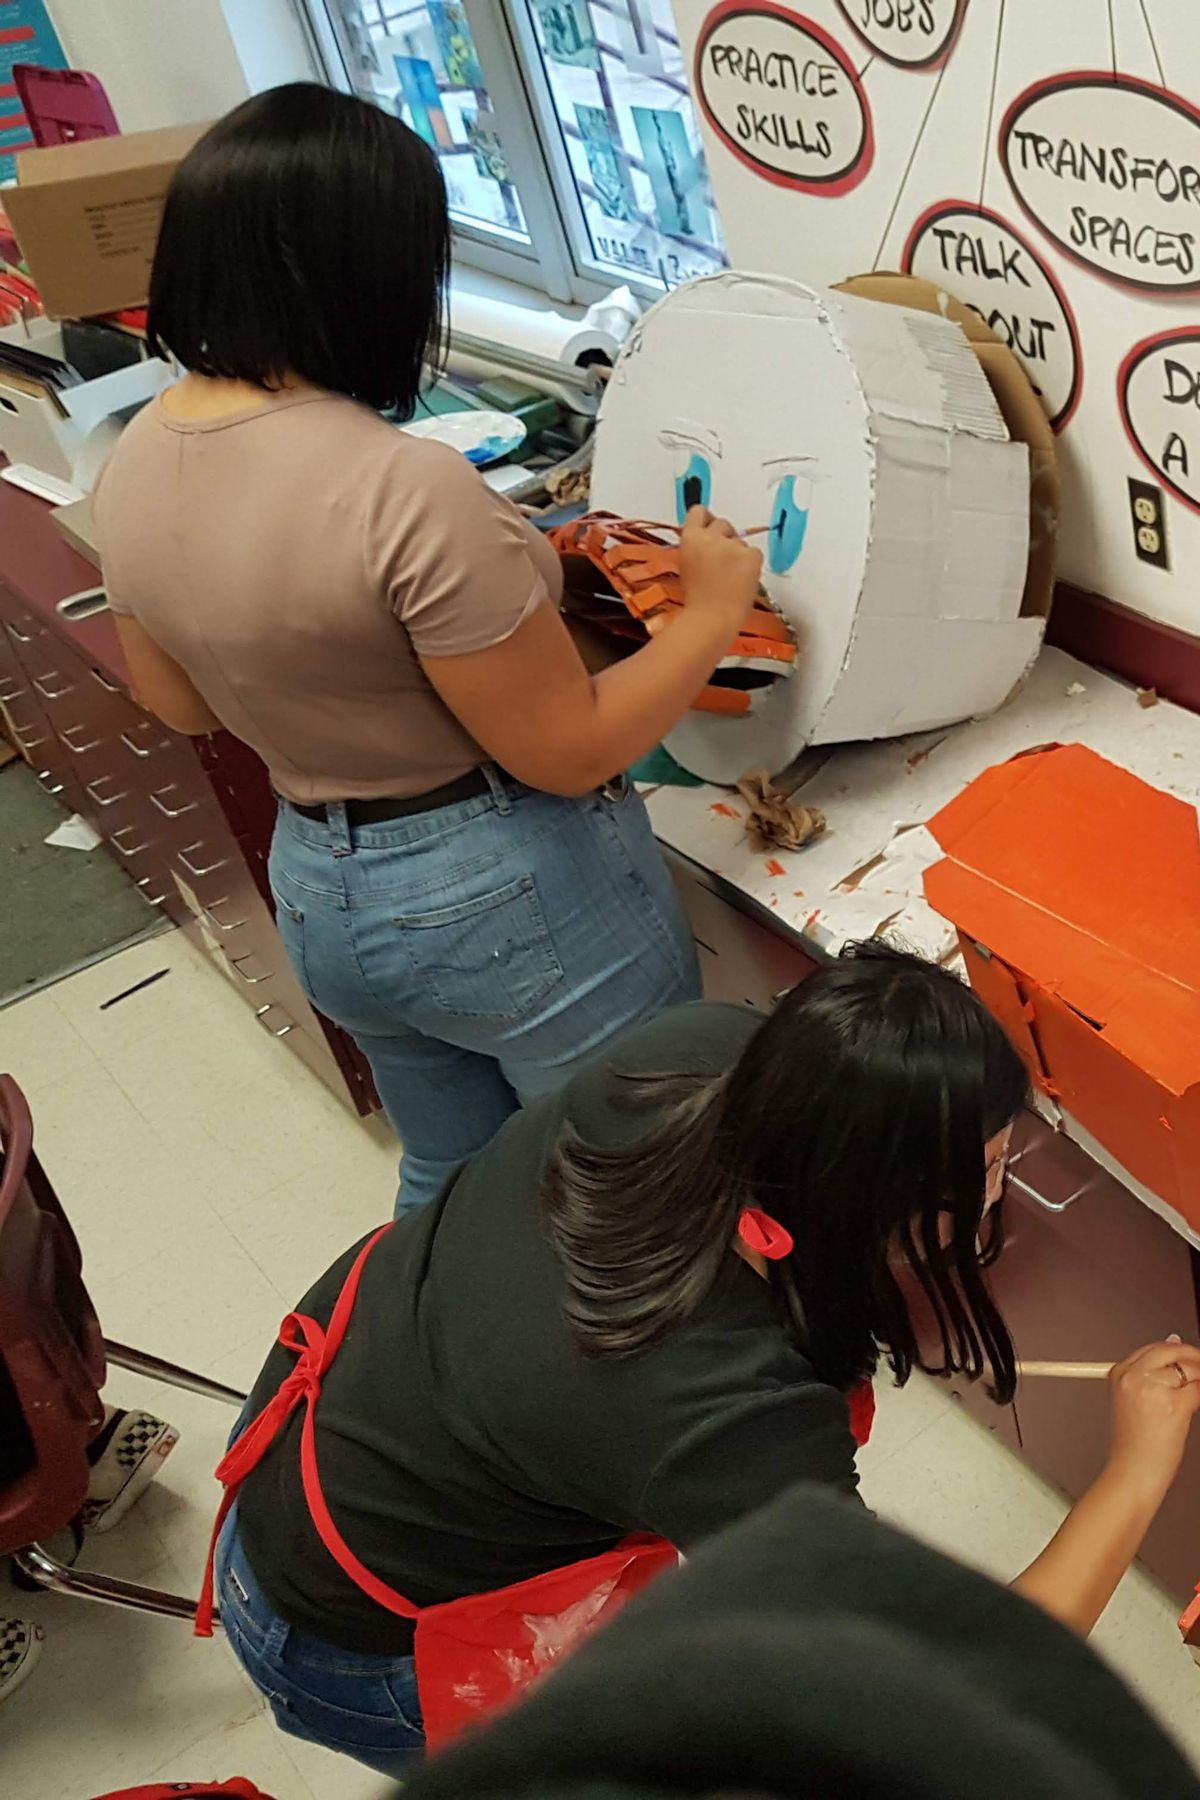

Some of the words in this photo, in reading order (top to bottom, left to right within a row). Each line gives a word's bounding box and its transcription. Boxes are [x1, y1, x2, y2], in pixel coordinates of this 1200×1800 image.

[861, 0, 935, 35] JOBS
[710, 44, 840, 97] PRACTICE
[736, 103, 831, 159] SKILLS
[932, 227, 1032, 287] TALK
[1069, 206, 1196, 275] SPACES
[965, 303, 1056, 361] OUT
[1162, 433, 1189, 478] A
